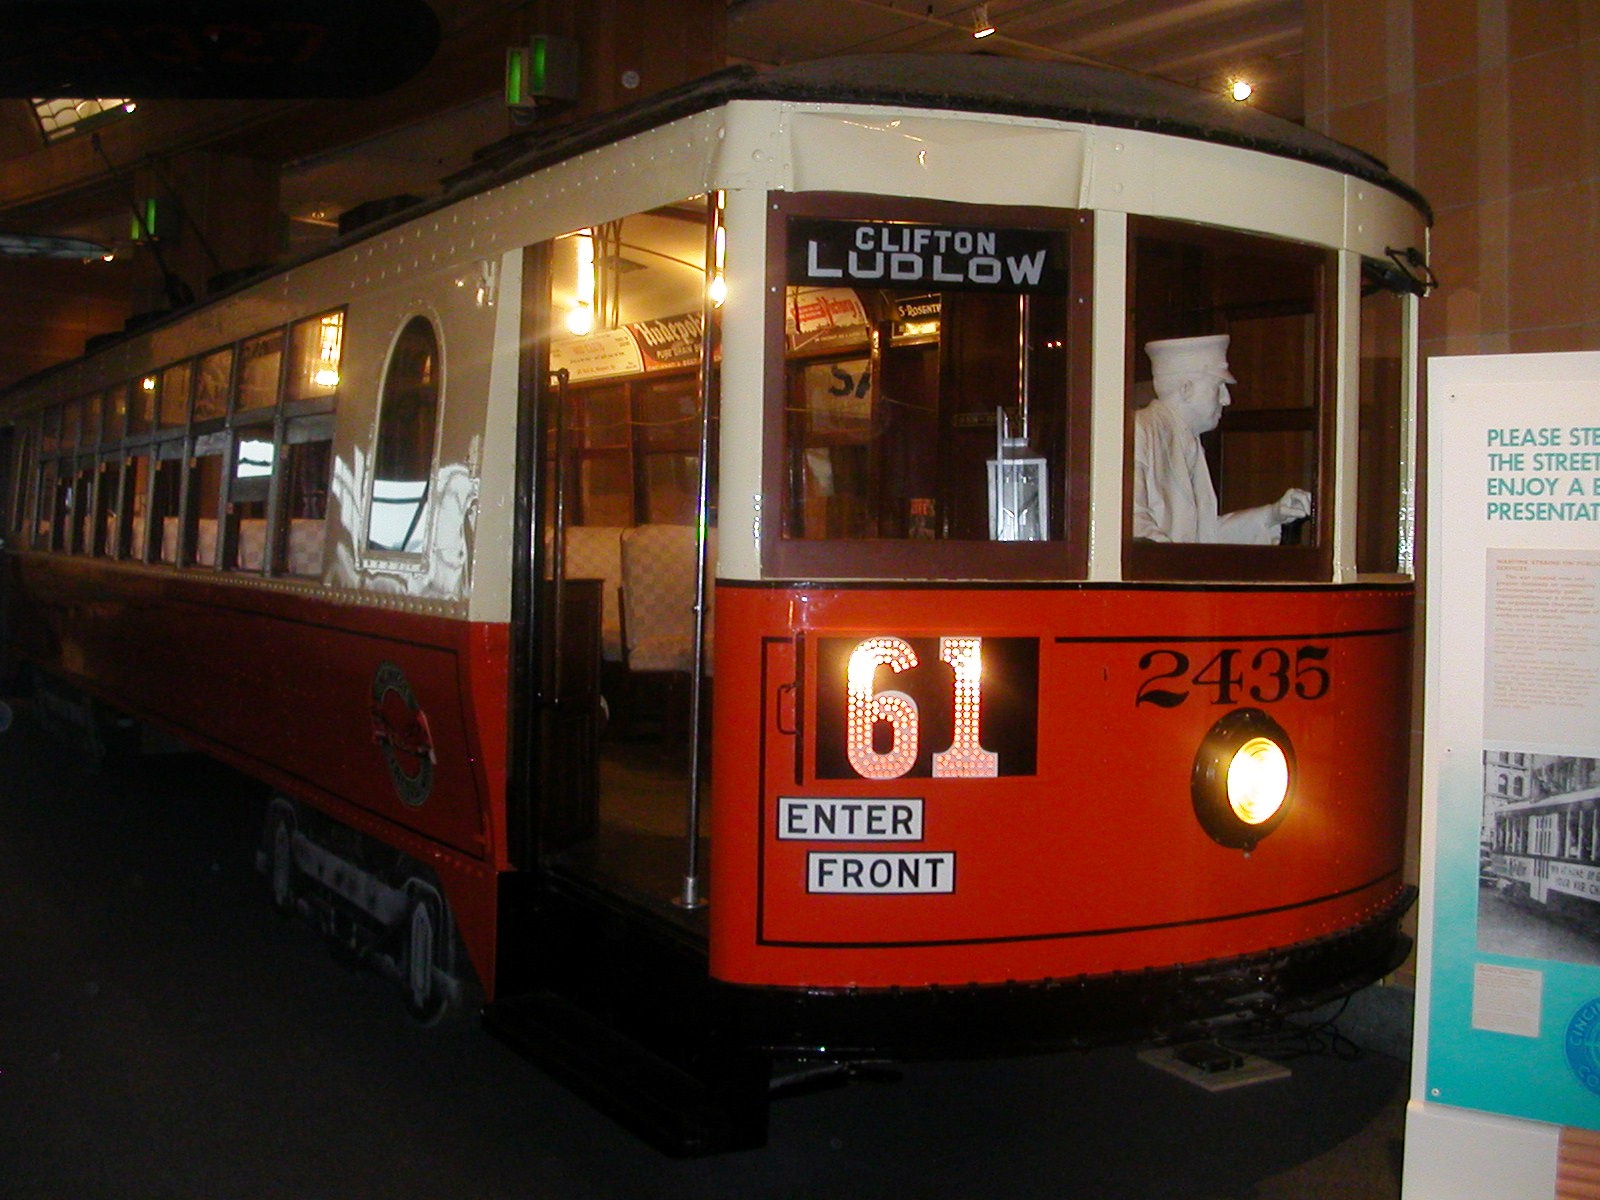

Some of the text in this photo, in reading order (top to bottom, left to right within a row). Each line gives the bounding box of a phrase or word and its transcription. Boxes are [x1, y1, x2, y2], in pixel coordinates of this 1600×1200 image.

[855, 226, 996, 256] CLIFTON
[807, 239, 1046, 286] LUDLOW
[1487, 426, 1600, 447] PLEASE STE
[1487, 452, 1600, 471] THE STREET
[1487, 477, 1559, 496] ENJOY
[1566, 477, 1585, 496] A
[1487, 502, 1600, 521] PRESENTAT
[1135, 645, 1330, 709] 2435
[847, 636, 998, 780] 61
[787, 803, 914, 835] ENTER
[817, 858, 945, 888] FRONT
